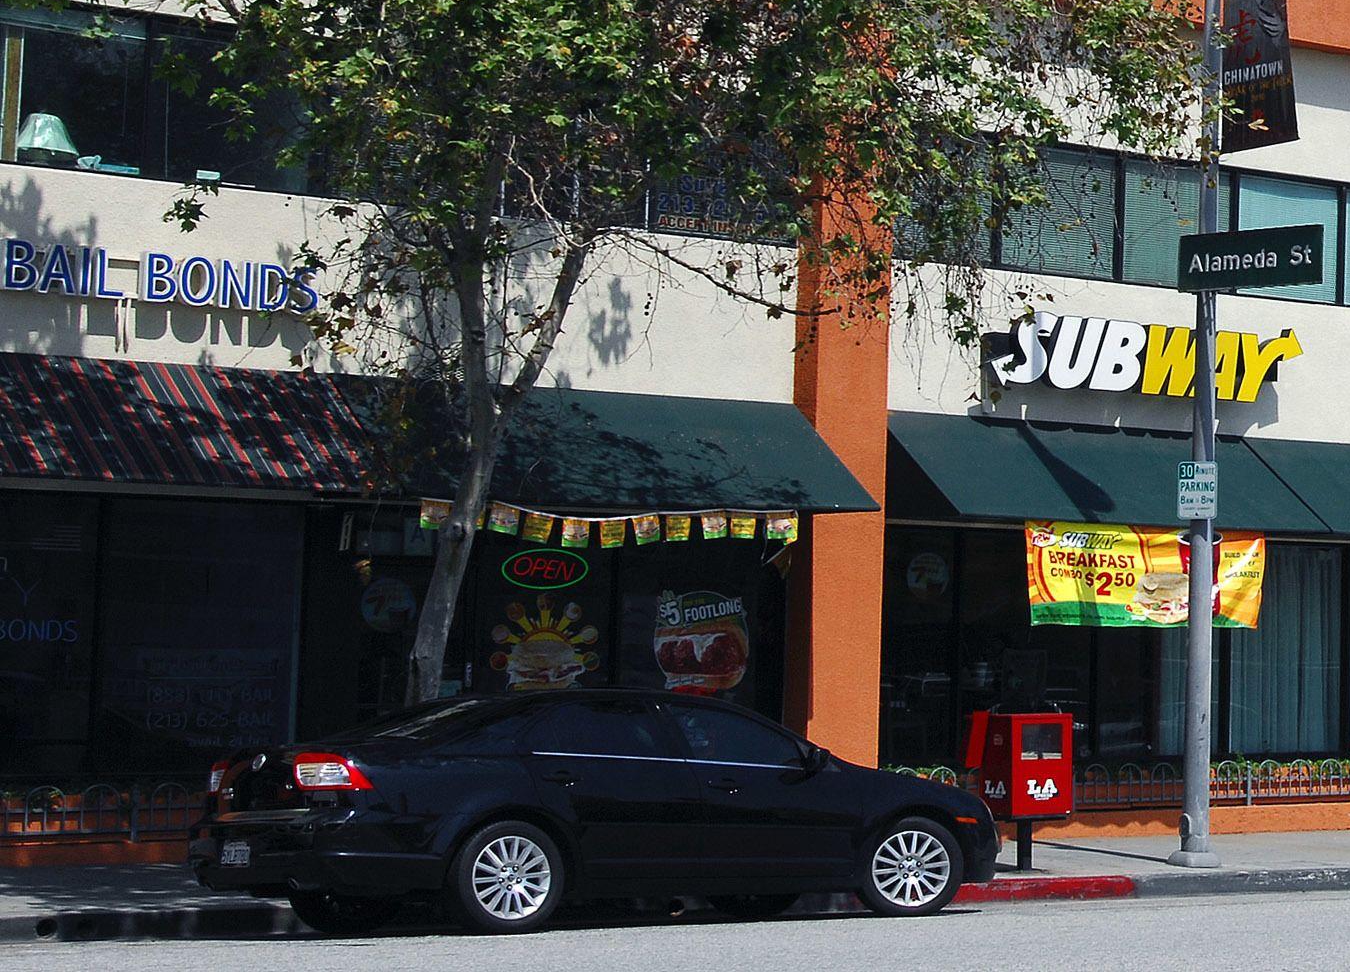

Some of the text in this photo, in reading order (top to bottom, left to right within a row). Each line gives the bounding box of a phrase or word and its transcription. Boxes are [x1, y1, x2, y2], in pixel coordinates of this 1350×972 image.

[1224, 60, 1283, 85] CHINATOWN
[1188, 244, 1313, 274] Alameda St
[4, 239, 319, 314] BAIL BONDS
[990, 311, 1304, 403] SUBWAY
[1180, 464, 1194, 478] 30
[1180, 481, 1215, 492] PARKING
[1058, 530, 1123, 550] SUBWAY
[513, 555, 576, 581] OPEN
[1048, 550, 1136, 570] BREAKFAST
[659, 597, 742, 626] $5 FOOTLONG
[984, 779, 1006, 795] LA
[1027, 778, 1058, 795] LA
